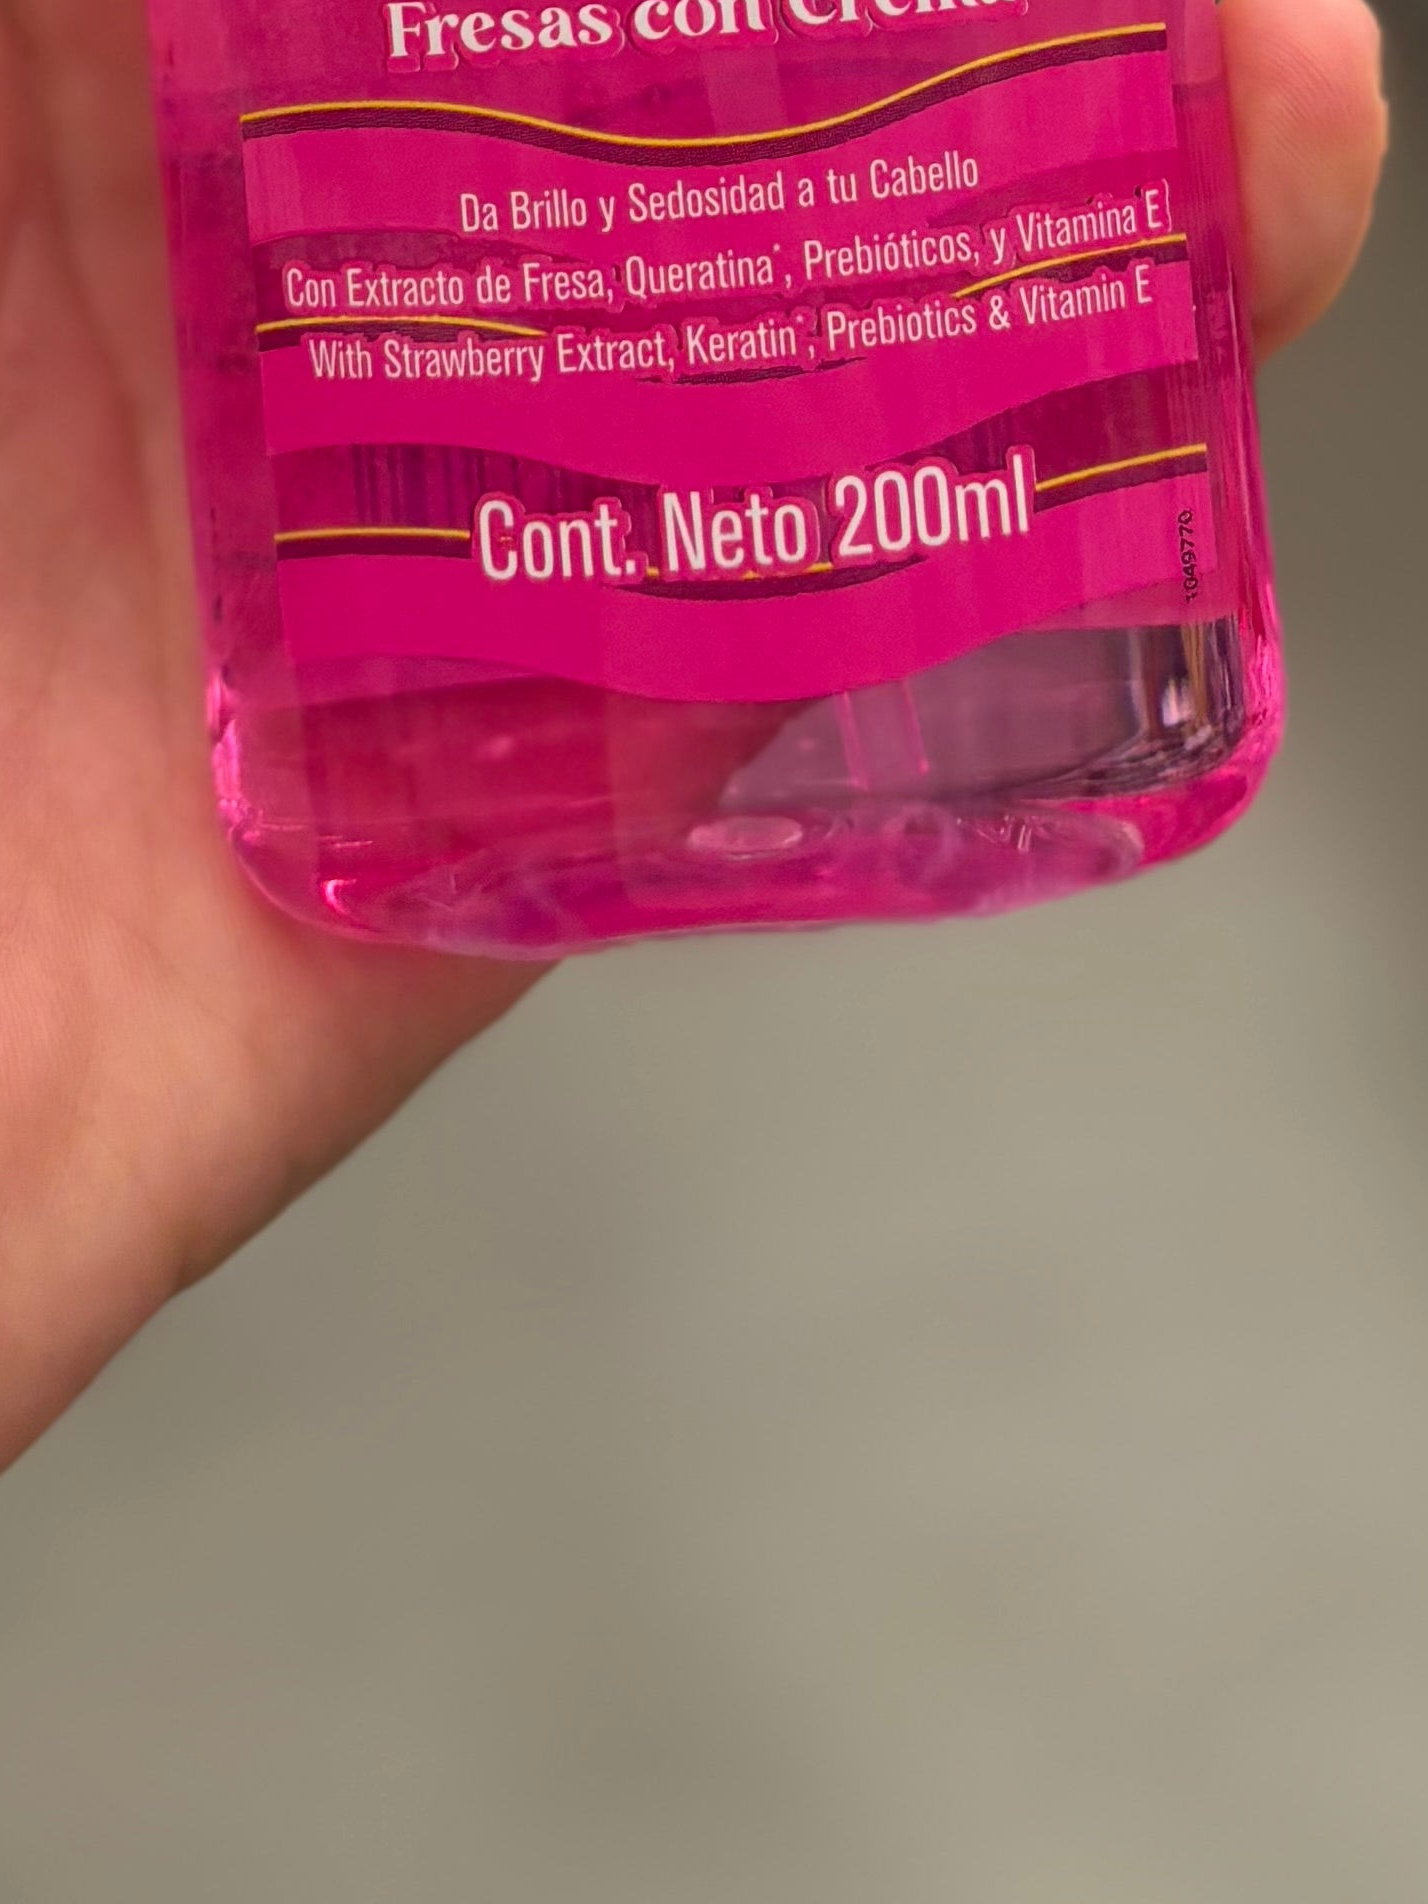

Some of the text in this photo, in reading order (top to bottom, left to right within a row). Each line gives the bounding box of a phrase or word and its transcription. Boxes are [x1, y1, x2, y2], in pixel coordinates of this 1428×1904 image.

[387, 0, 616, 59] Fresas
[285, 266, 336, 308] Con
[346, 264, 465, 308] Extracto
[476, 264, 511, 304] de
[523, 260, 614, 305] Fresa,
[803, 228, 980, 279] Prebióticos,
[990, 224, 1007, 265] y
[1016, 201, 1137, 250] Vitamina
[1145, 188, 1163, 229] E
[459, 149, 979, 233] Da Brillo y Sedosidad a tu Cabello
[309, 336, 373, 380] With
[383, 335, 545, 382] Strawberry
[556, 330, 676, 373] Extract,
[826, 299, 977, 352] Prebiotics
[988, 293, 1011, 331] &
[1019, 274, 1127, 326] Vitamin
[1135, 264, 1154, 304] E
[475, 453, 1033, 582] Cont. Neto 200ml
